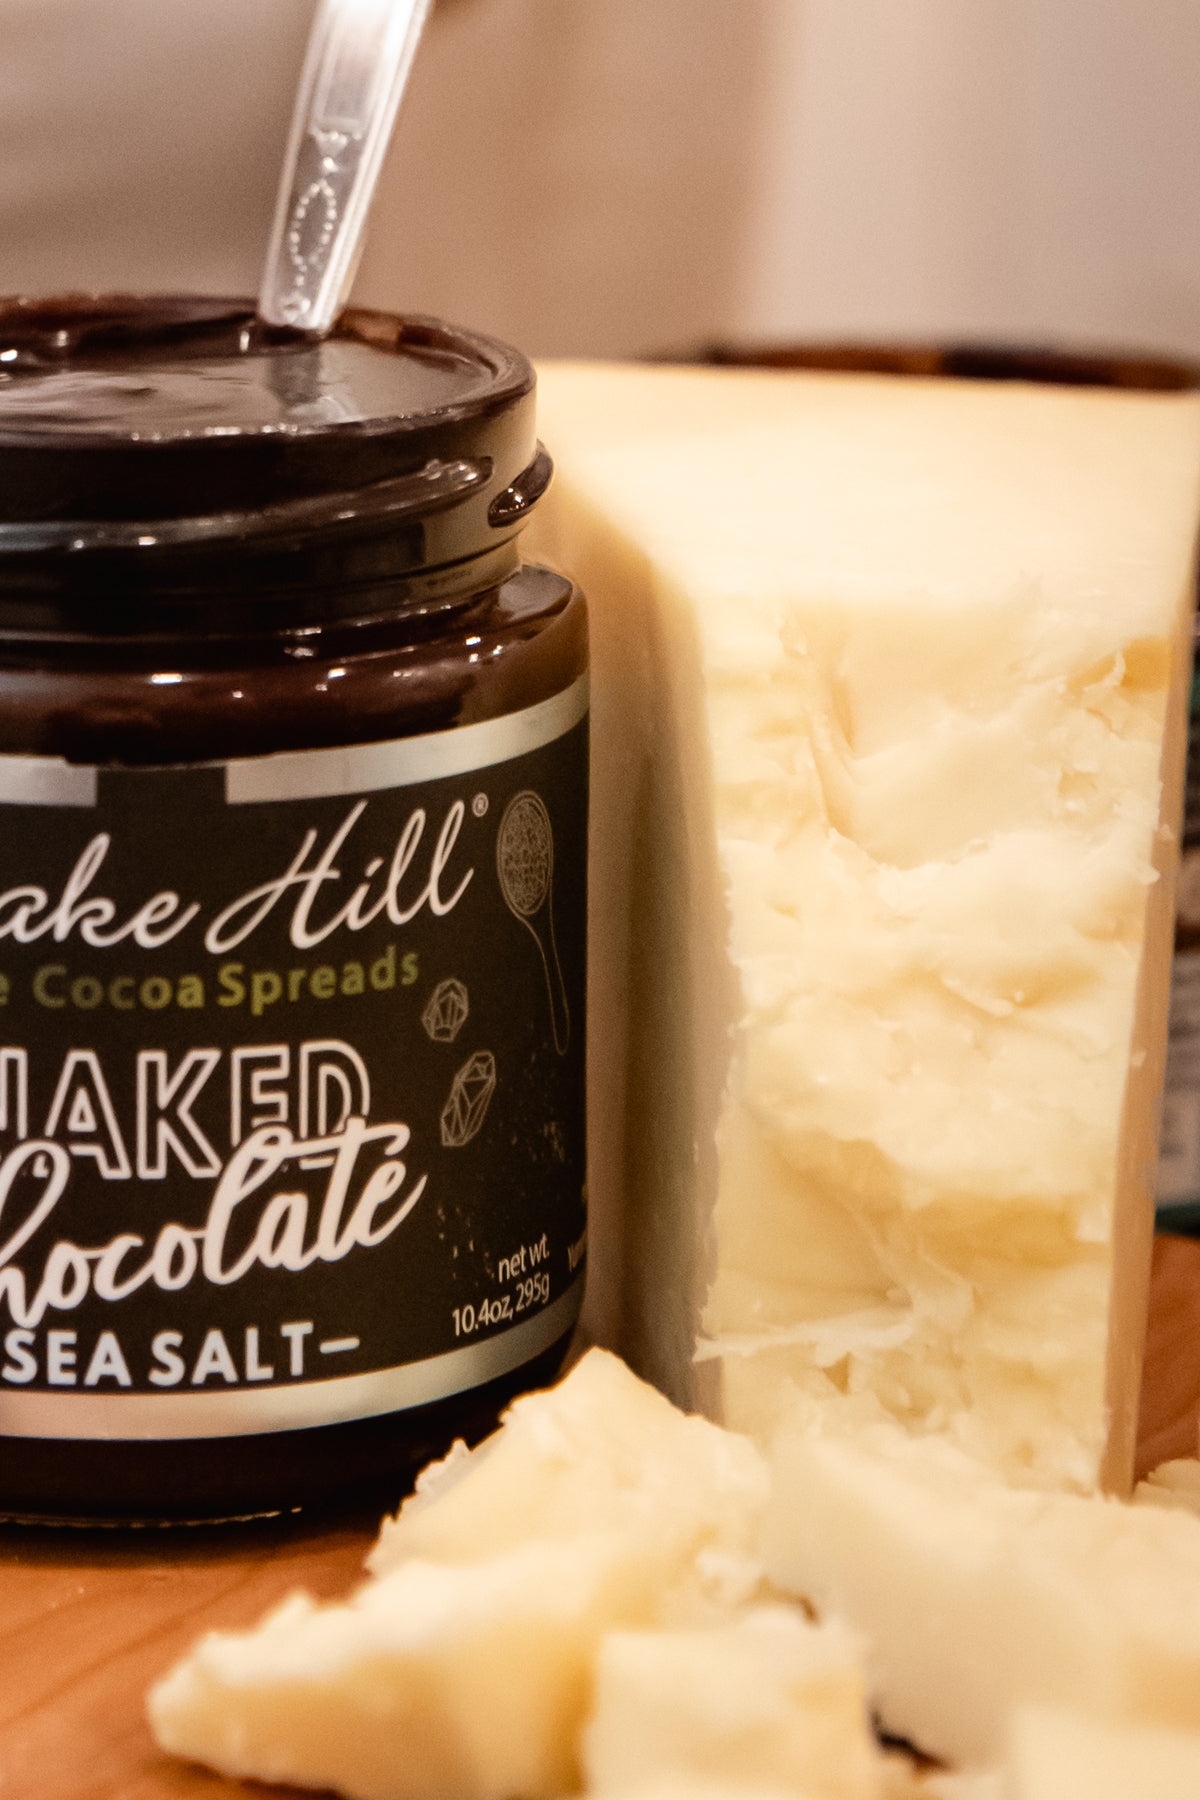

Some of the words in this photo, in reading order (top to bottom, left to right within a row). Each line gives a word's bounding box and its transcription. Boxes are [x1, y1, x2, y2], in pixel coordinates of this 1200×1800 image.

[33, 964, 204, 1010] Cocoa
[217, 946, 420, 1015] Spreads
[499, 1245, 526, 1283] net
